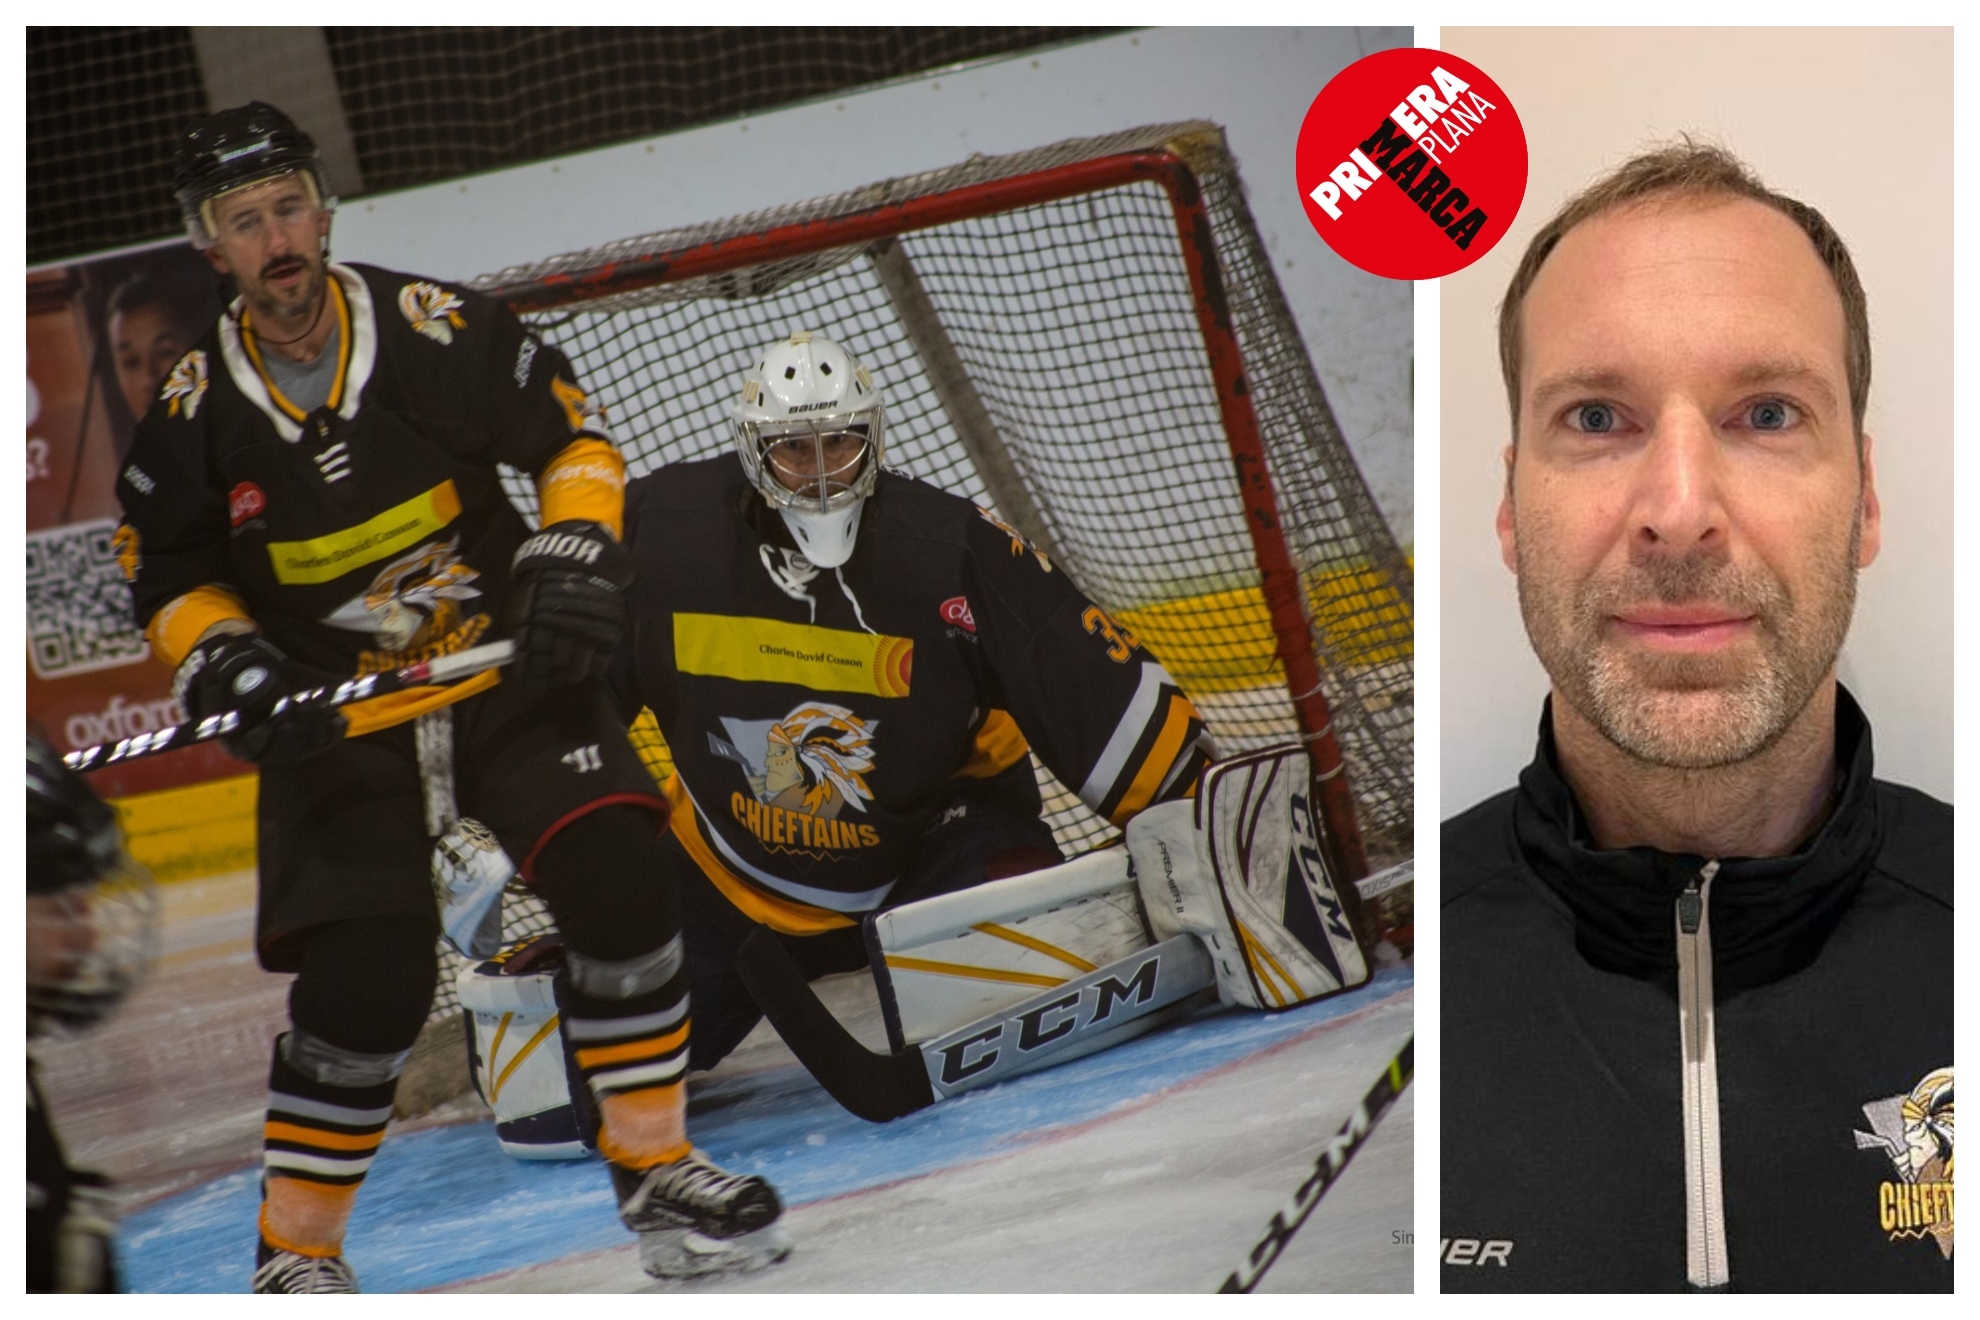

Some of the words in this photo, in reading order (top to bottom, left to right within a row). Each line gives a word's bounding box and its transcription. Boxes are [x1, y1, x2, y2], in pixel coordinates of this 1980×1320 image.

[759, 644, 795, 658] Charles
[796, 650, 825, 663] David
[826, 654, 863, 668] Casson
[730, 791, 881, 849] CHIEFTAINS
[1157, 841, 1183, 904] PREMIER
[1290, 792, 1354, 942] CCM
[931, 954, 1161, 1087] CCM
